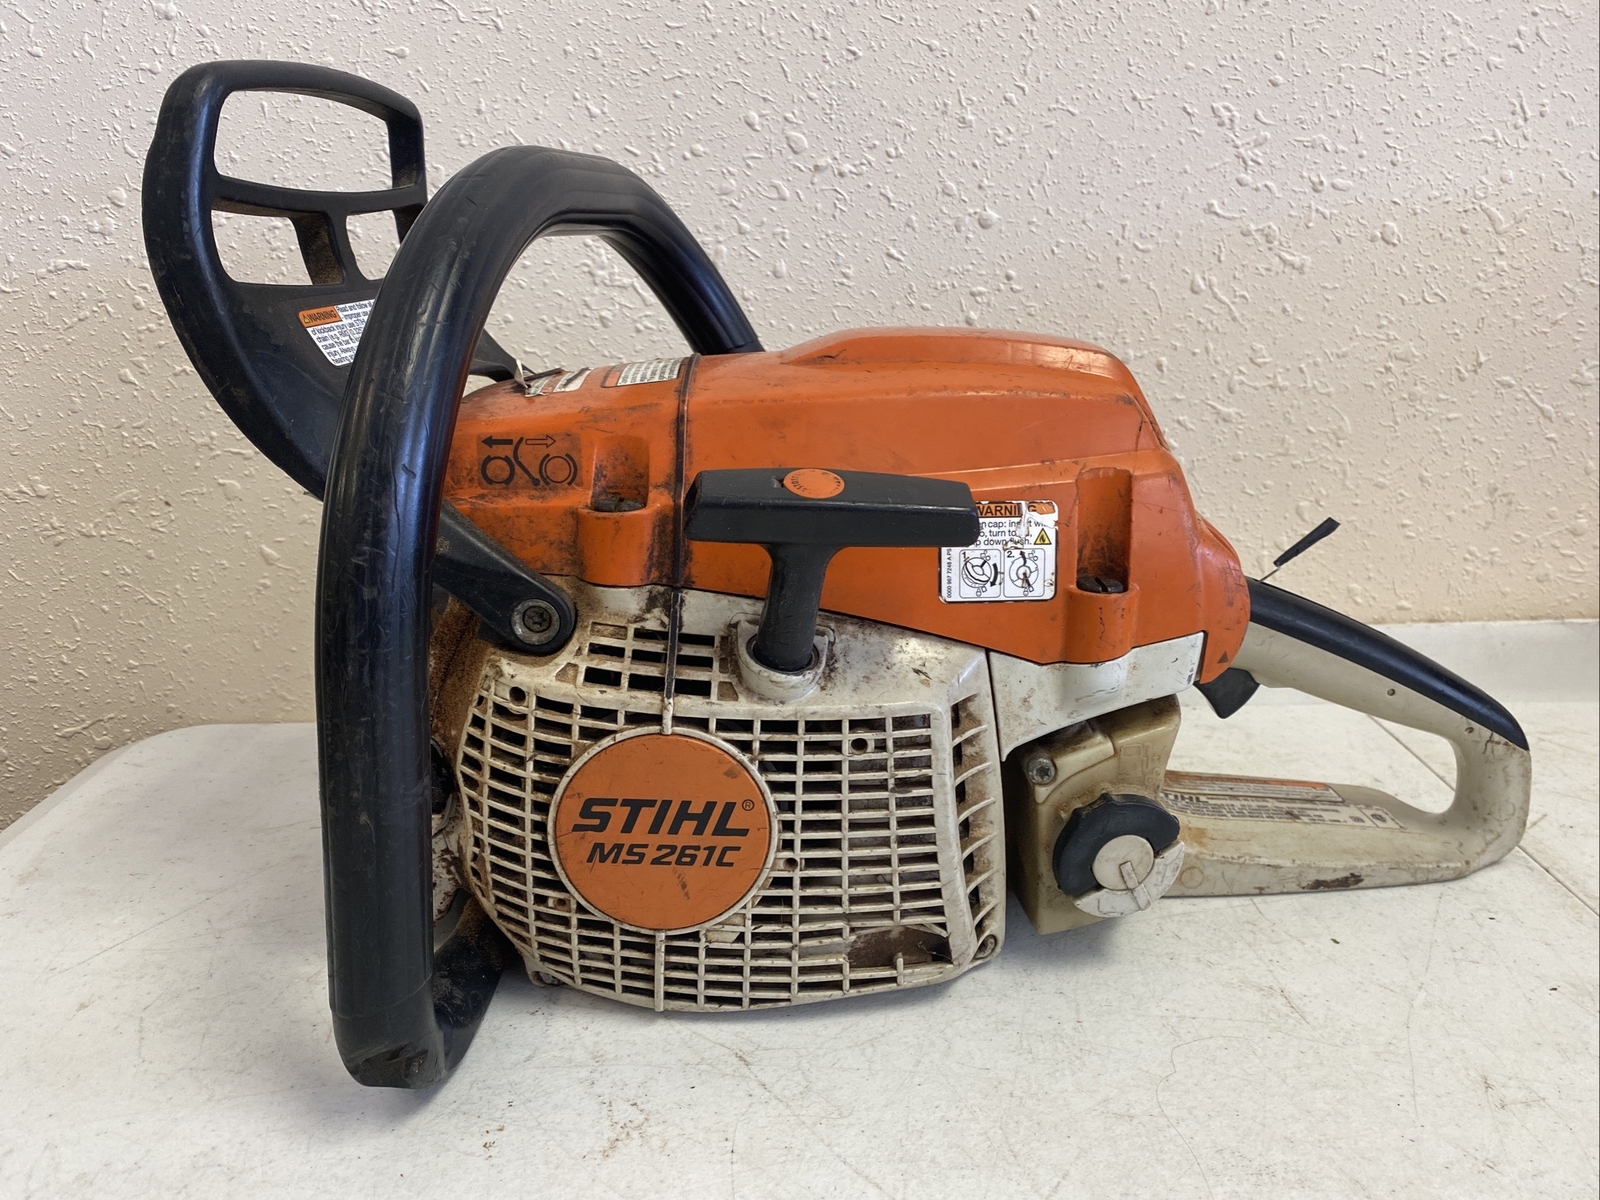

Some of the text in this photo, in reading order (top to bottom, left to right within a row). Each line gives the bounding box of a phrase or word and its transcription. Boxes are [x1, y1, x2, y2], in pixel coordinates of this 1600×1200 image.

[308, 310, 338, 322] WARNING
[316, 324, 335, 334] kickback
[316, 335, 328, 343] chain
[322, 342, 336, 350] cause
[988, 521, 1006, 530] cap:
[1006, 550, 1015, 558] 2.
[1162, 792, 1208, 804] TIHL
[586, 842, 742, 867] MS 261C
